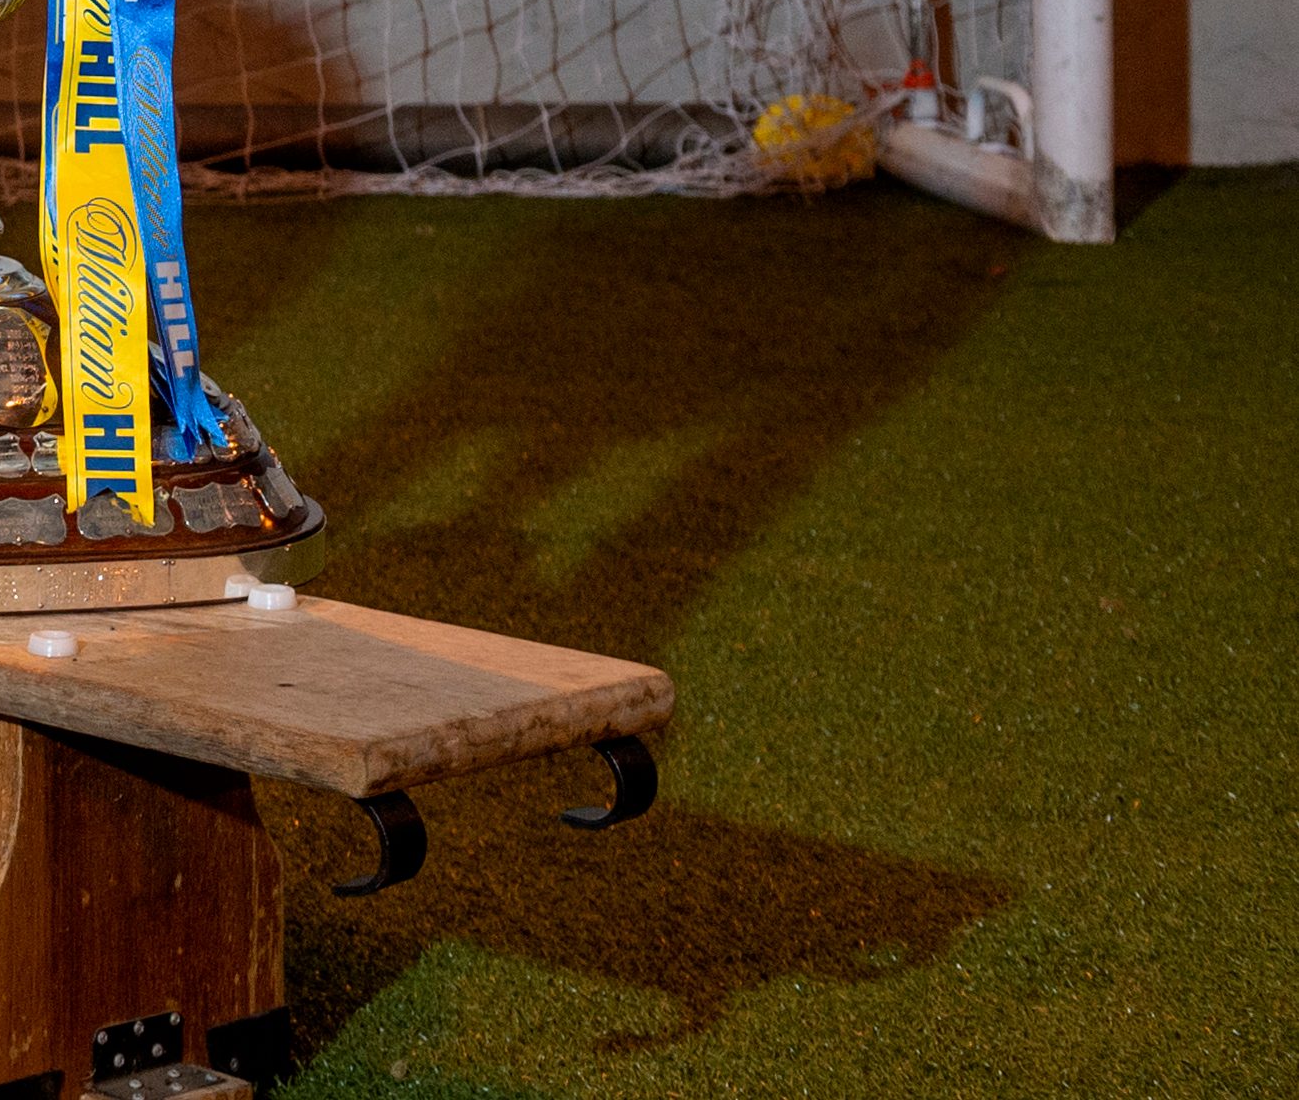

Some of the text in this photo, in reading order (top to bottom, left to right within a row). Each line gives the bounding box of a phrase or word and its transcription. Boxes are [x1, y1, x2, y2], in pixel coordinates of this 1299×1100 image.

[73, 39, 124, 154] HILL
[69, 197, 137, 410] William
[155, 261, 196, 379] HILL
